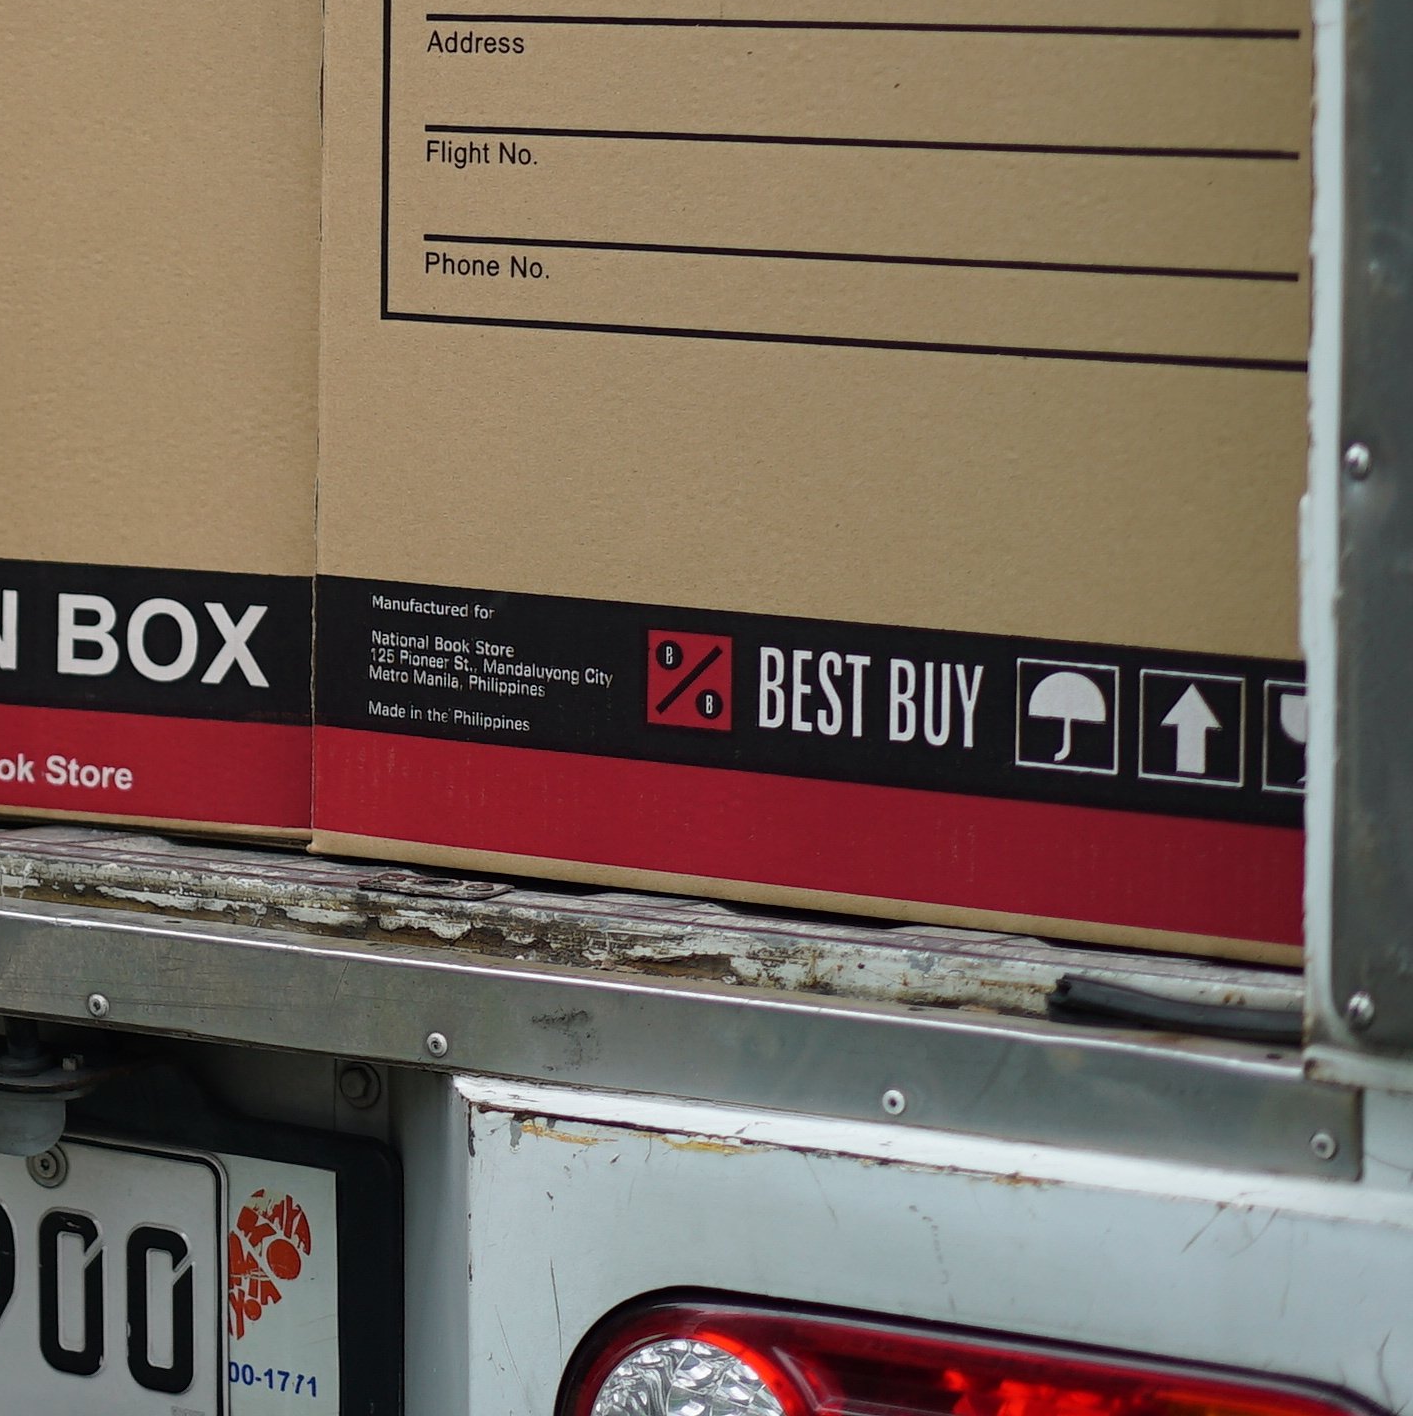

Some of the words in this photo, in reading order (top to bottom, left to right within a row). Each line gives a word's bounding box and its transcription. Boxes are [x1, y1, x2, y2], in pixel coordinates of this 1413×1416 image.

[427, 31, 525, 54] Address
[426, 141, 490, 169] Flight
[499, 143, 538, 165] No.
[425, 252, 500, 277] Phone
[511, 256, 549, 280] No.
[372, 595, 469, 617] Manufactured
[474, 604, 495, 619] for
[57, 593, 270, 688] BOX
[371, 629, 429, 650] National
[435, 636, 470, 653] Book
[475, 640, 514, 658] Store
[369, 664, 408, 683] Metro
[413, 669, 463, 691] Manila,
[469, 674, 546, 697] Philippines
[370, 647, 395, 663] 125
[399, 649, 449, 669] Pioneer
[483, 658, 579, 685] Mandaluyong
[584, 668, 613, 688] City
[759, 646, 871, 737] BEST
[889, 658, 984, 748] BUY
[368, 700, 406, 718] Made
[410, 705, 423, 720] in
[427, 708, 449, 723] the
[453, 709, 530, 731] Philippines
[45, 755, 133, 790] Store
